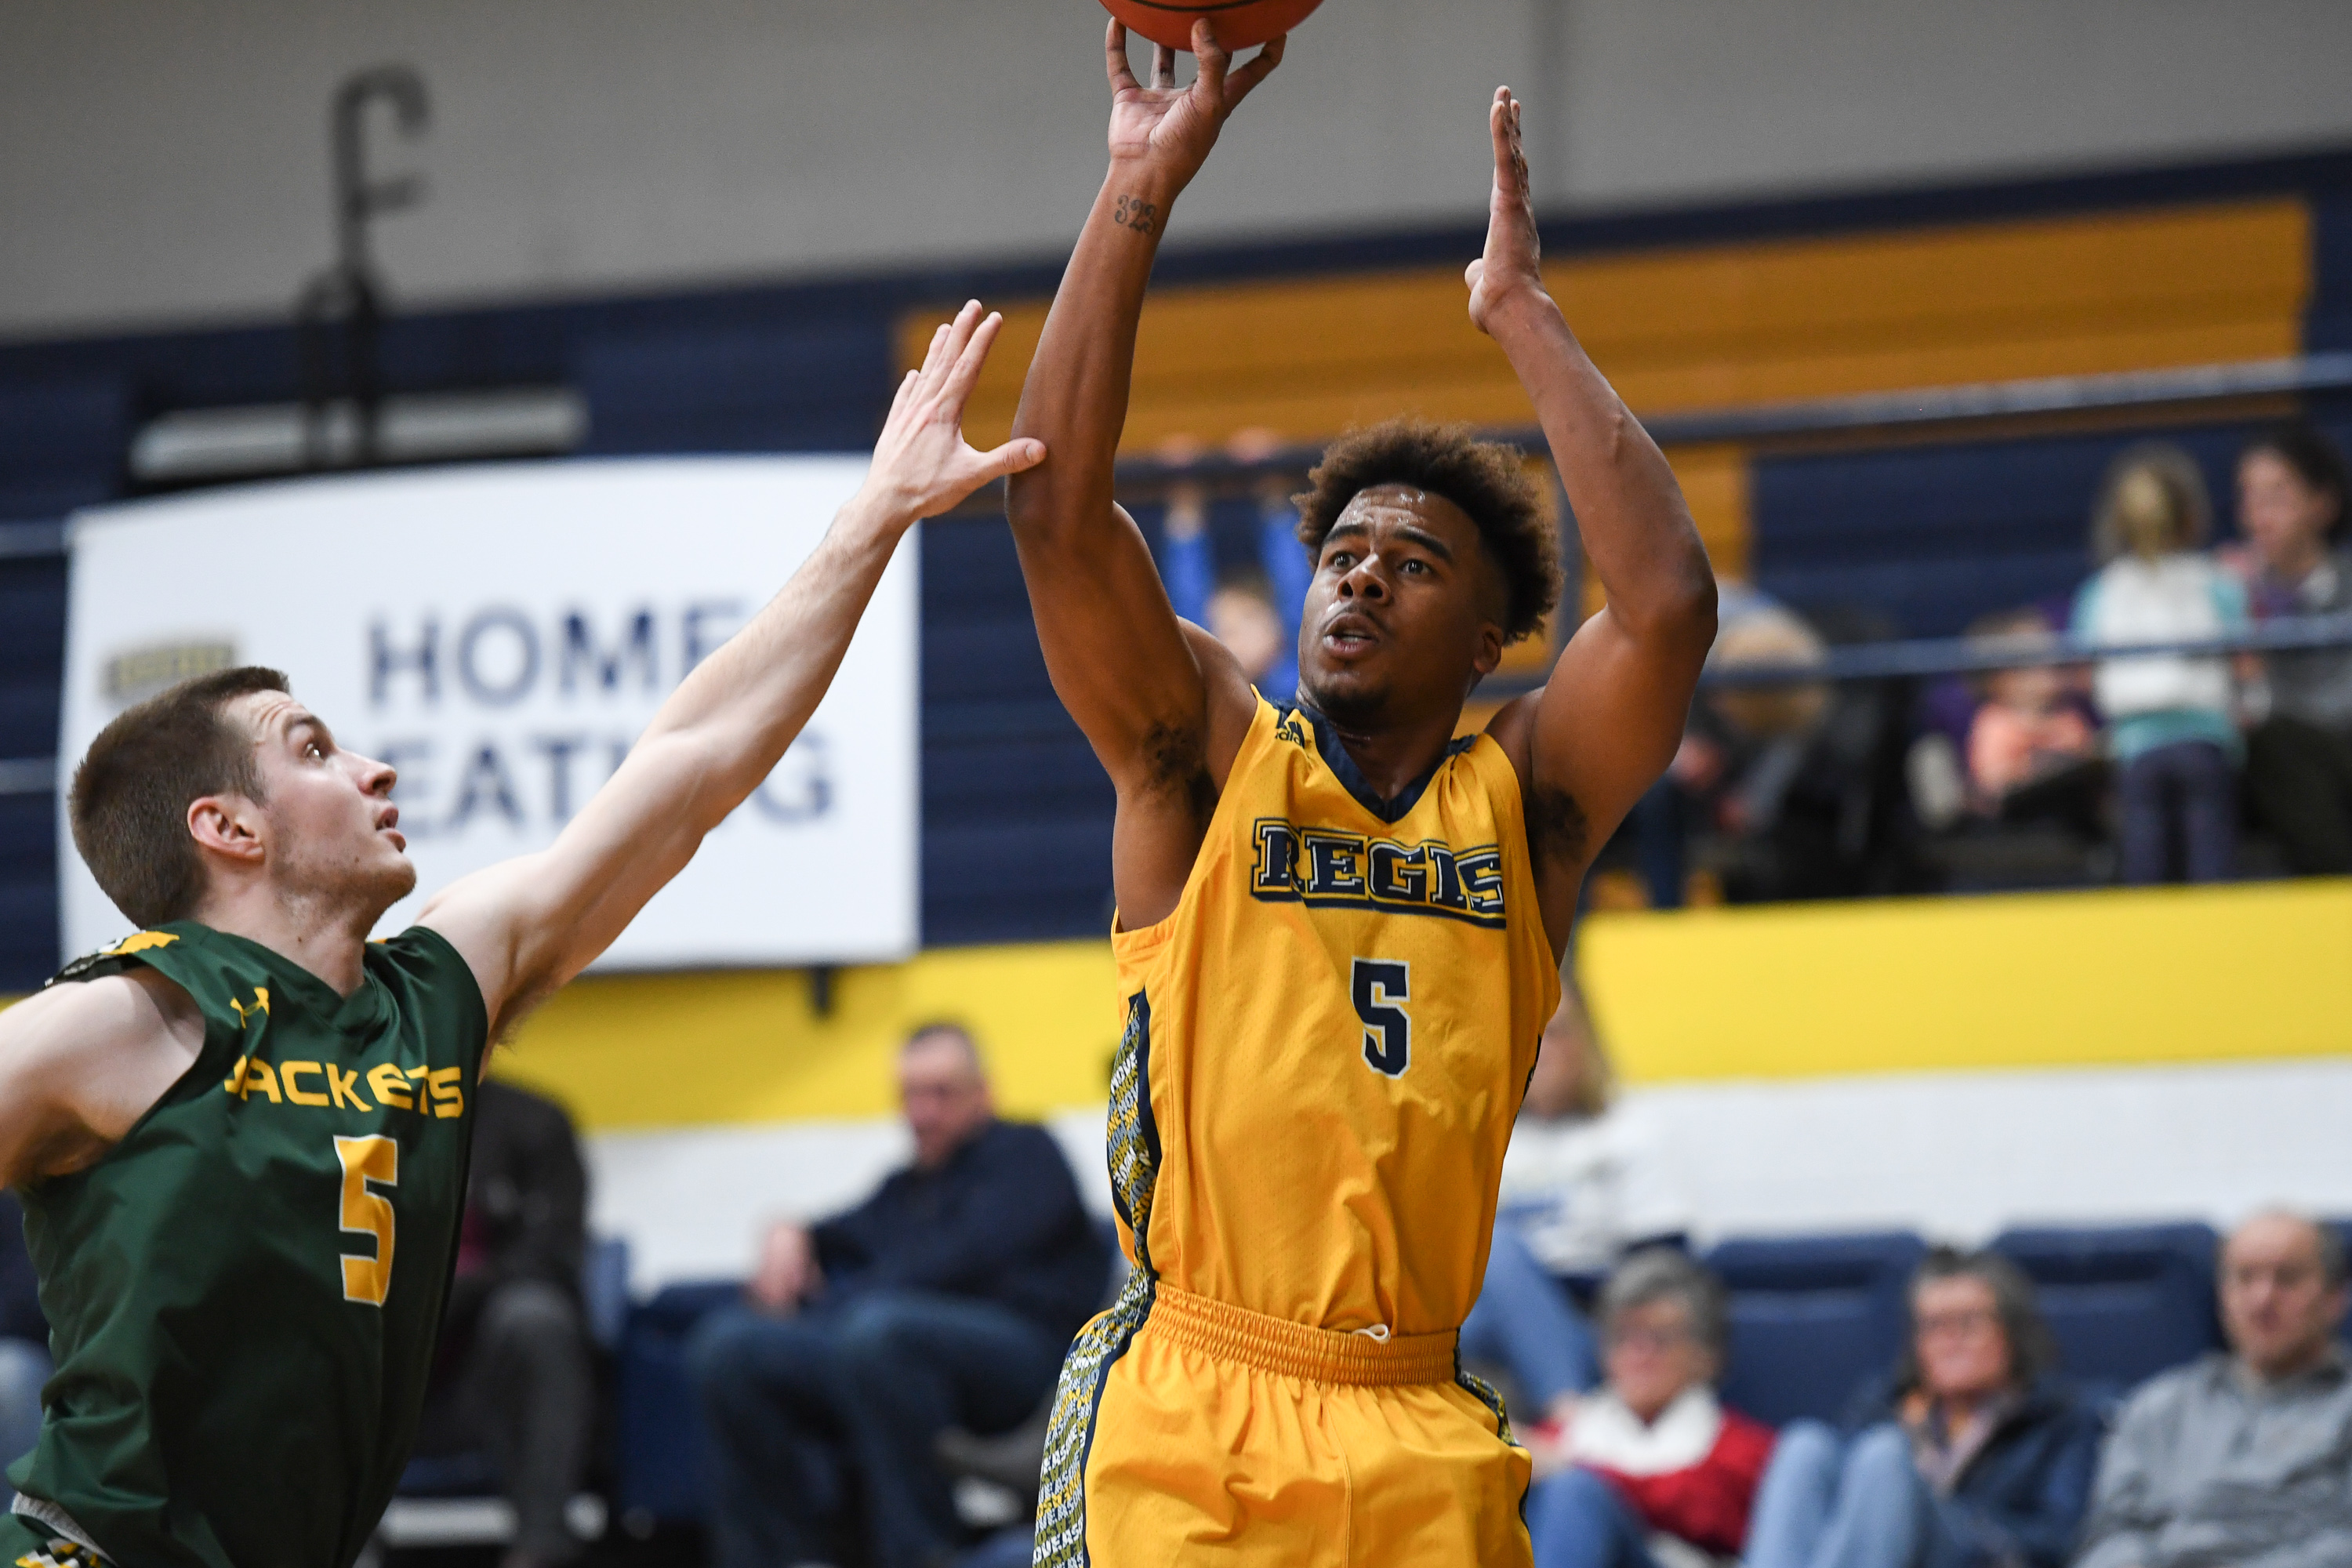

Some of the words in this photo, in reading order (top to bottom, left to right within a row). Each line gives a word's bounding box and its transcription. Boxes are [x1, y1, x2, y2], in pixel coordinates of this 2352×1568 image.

[1252, 818, 1505, 925] REGIS
[1350, 956, 1410, 1079] 5
[333, 1134, 397, 1307] 5
